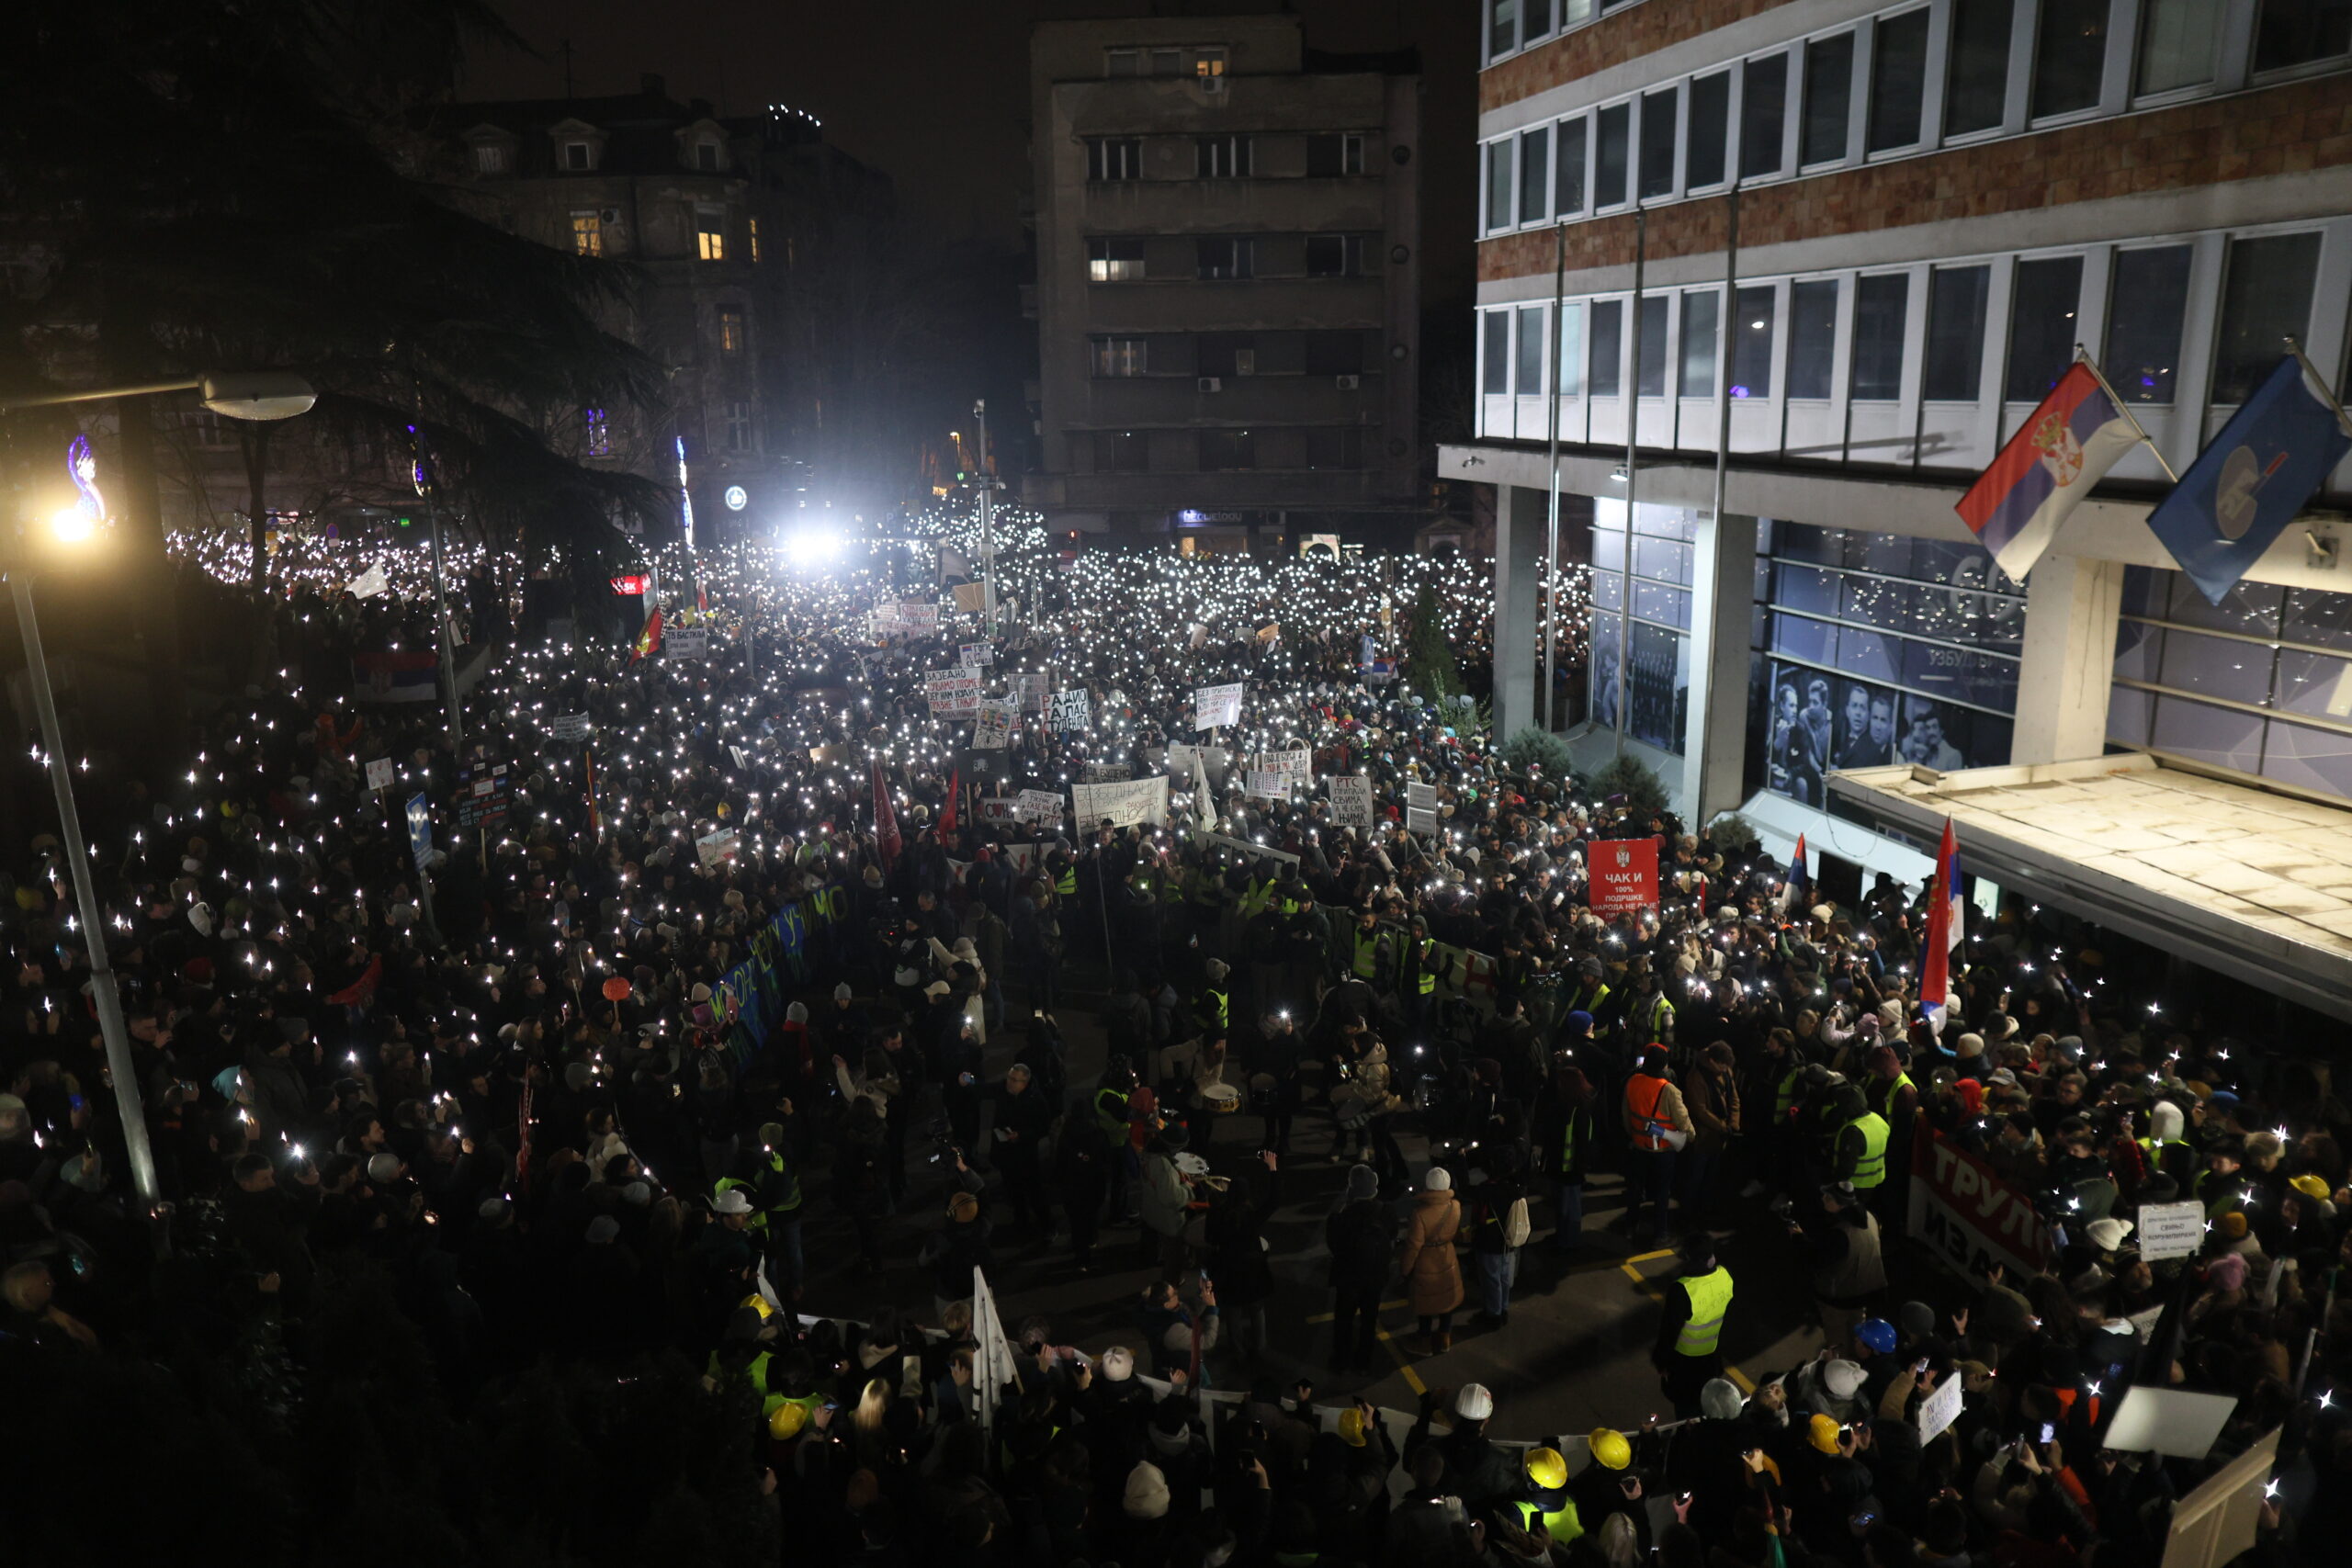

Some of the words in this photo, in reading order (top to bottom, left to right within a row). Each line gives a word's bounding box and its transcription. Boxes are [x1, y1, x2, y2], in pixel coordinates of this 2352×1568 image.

[926, 670, 967, 682] ЗАЈЕДНО
[1042, 690, 1087, 707] РАДИО
[1042, 703, 1087, 720] ТАЛАС
[1336, 778, 1358, 787] РТС
[1338, 814, 1367, 824] ЊИМА
[1605, 873, 1631, 883] ЧАК
[1634, 873, 1643, 882] И
[1605, 894, 1644, 902] ПОДРШКЕ
[1592, 903, 1624, 911] НАРОДА
